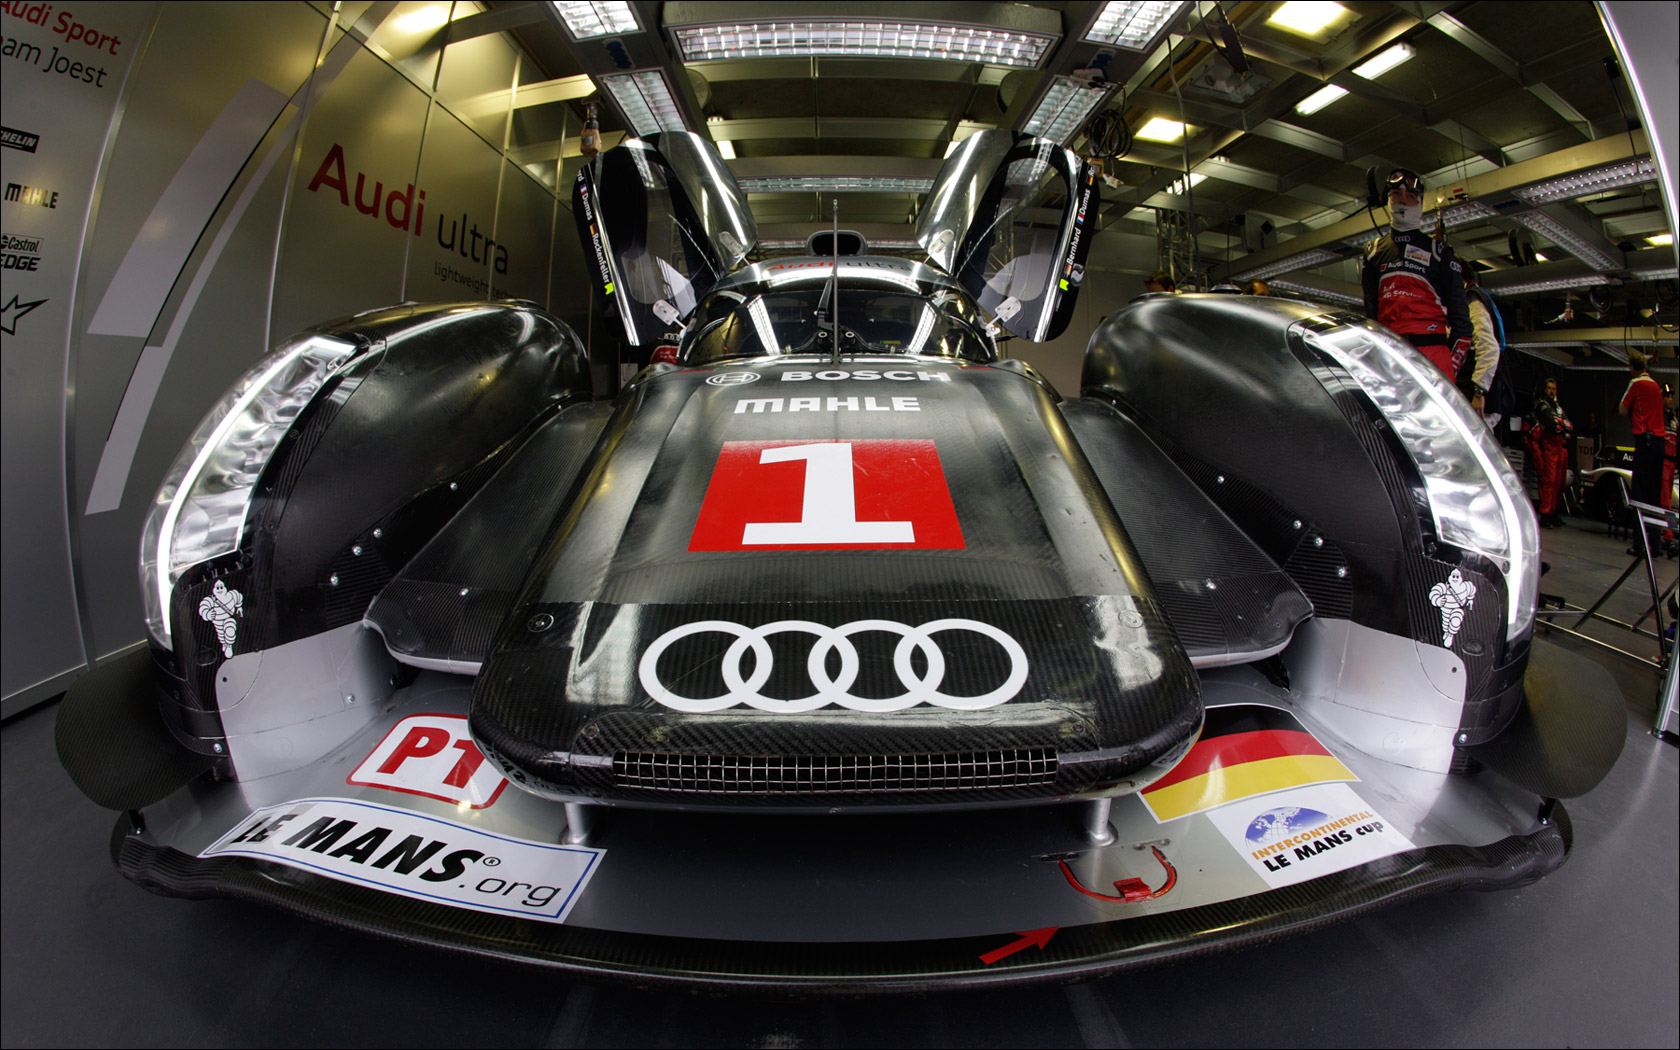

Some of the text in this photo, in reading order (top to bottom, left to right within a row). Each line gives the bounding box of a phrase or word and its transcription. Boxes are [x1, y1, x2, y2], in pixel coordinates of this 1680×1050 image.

[53, 11, 121, 56] Sport
[1, 36, 107, 88] am Joest
[1, 131, 37, 147] HELIN
[4, 182, 59, 209] MAHLE
[307, 143, 509, 276] Audi ultra
[582, 192, 593, 221] Dumas
[1079, 189, 1091, 216] Dumas
[7, 236, 40, 253] Castrol
[592, 232, 610, 283] Rockenfeller
[1067, 227, 1082, 266] Bernhard
[1388, 260, 1426, 273] Audi Sport
[780, 370, 952, 382] BOSCH
[733, 396, 922, 413] MAHLE
[741, 442, 916, 545] 1
[375, 726, 485, 789] P1
[230, 813, 299, 844] LE
[1251, 810, 1375, 861] INTERCONTINENTAL
[1263, 854, 1292, 873] LE
[1293, 830, 1354, 861] MANS
